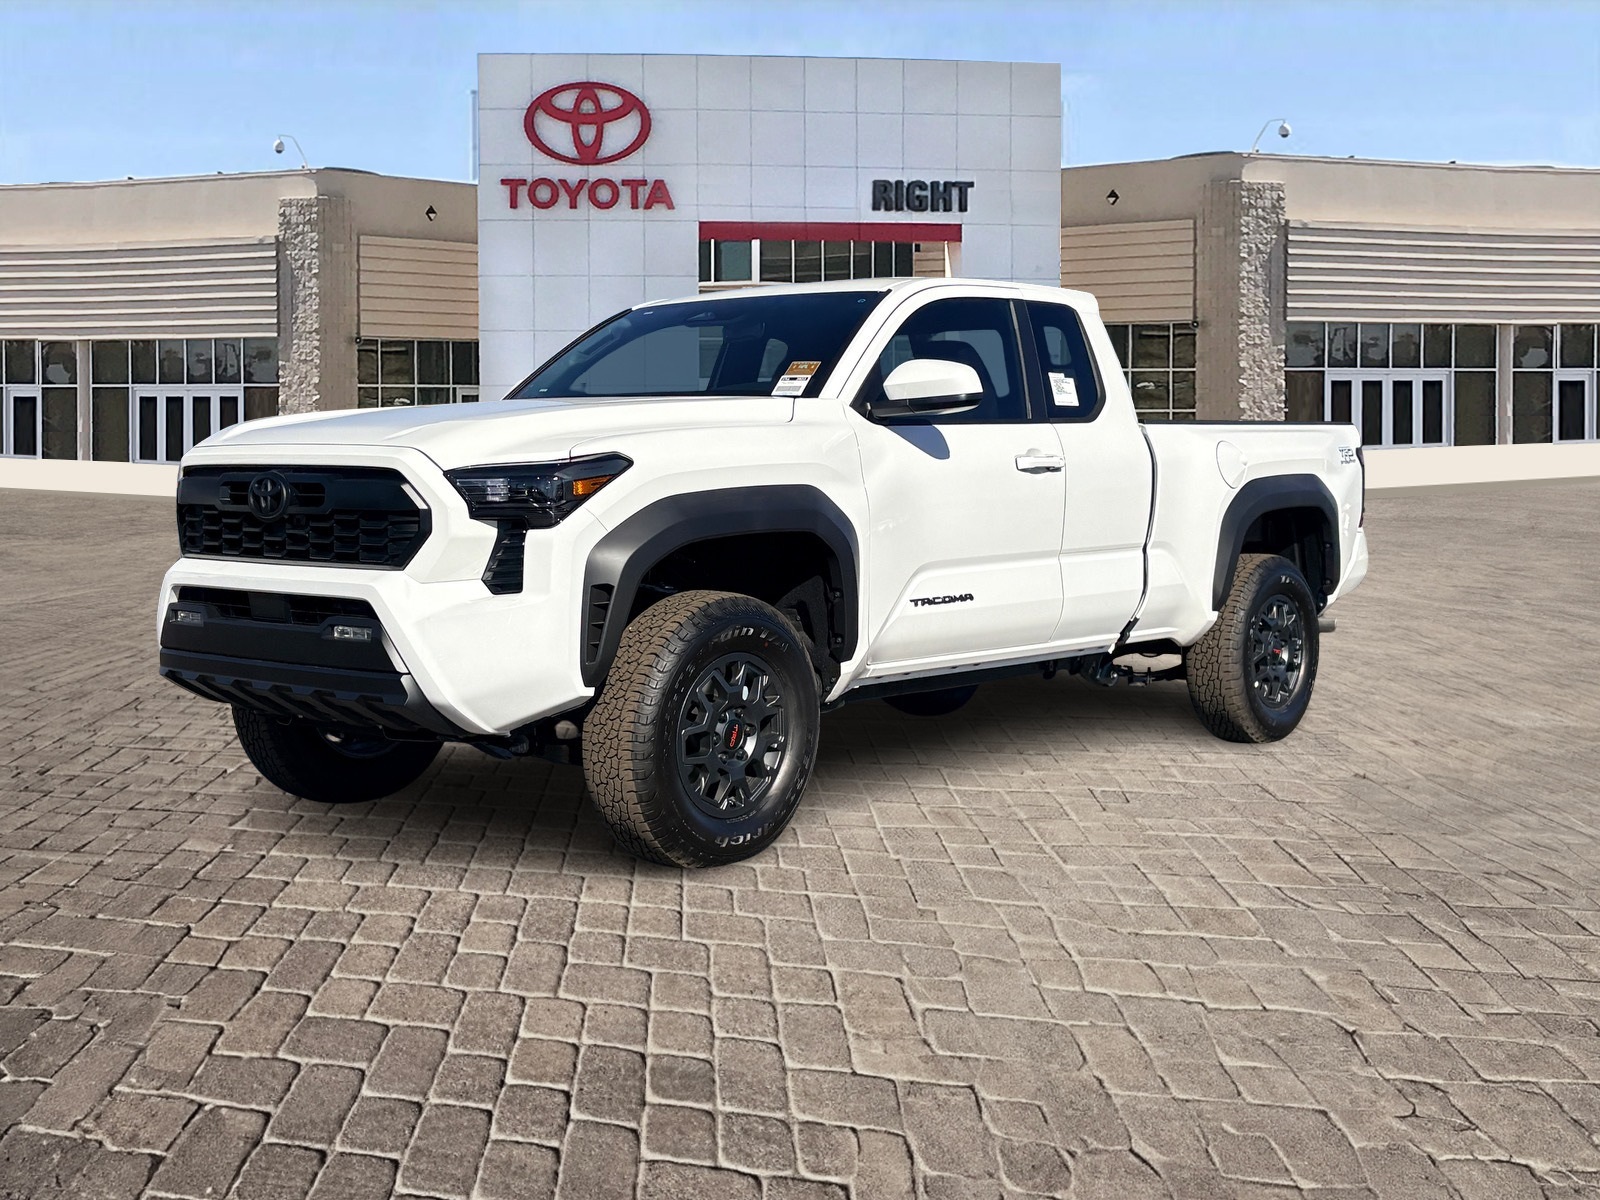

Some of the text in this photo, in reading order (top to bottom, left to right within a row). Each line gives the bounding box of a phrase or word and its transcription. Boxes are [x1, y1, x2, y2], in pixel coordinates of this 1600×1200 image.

[500, 177, 676, 210] TOYOTA
[871, 179, 975, 212] RIGHT
[909, 593, 974, 607] TACOMA
